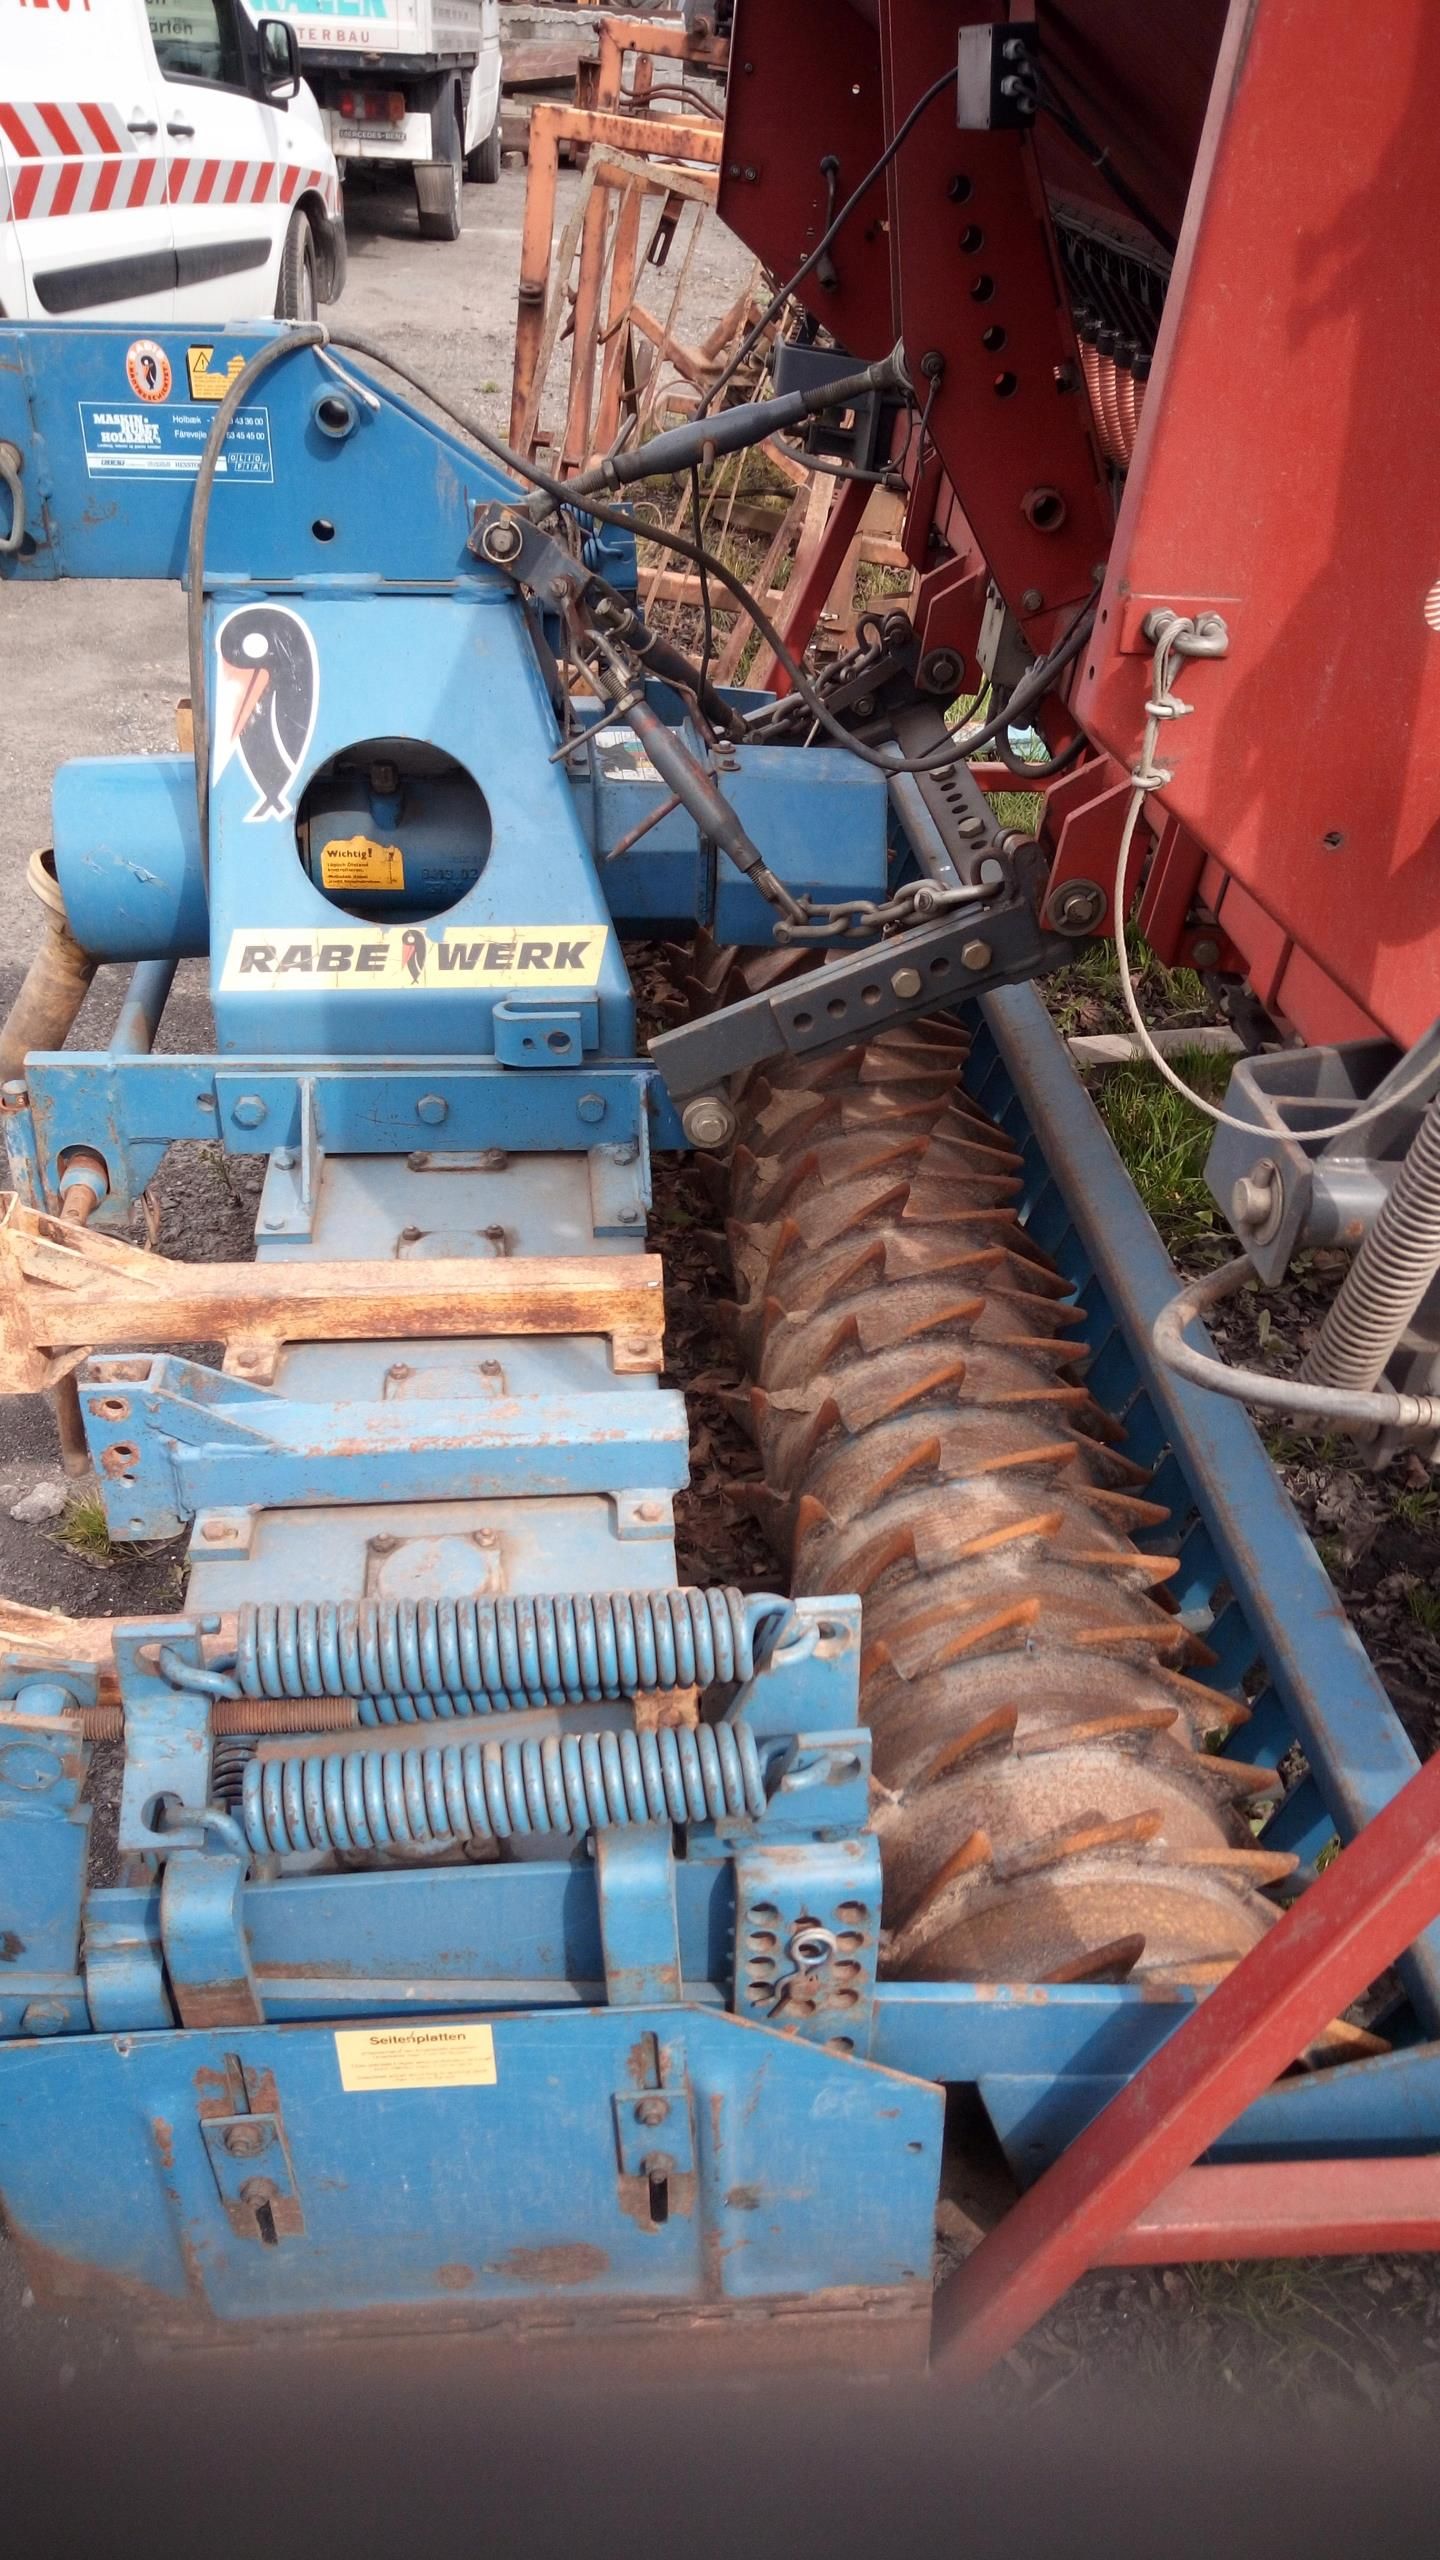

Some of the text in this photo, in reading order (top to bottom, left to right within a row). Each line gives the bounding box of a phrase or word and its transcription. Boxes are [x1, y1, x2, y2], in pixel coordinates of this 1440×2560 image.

[296, 27, 370, 43] TERBAU
[327, 848, 373, 860] Wichtig!
[239, 941, 592, 973] RABE WERK
[369, 2032, 467, 2046] Seitenplatten
